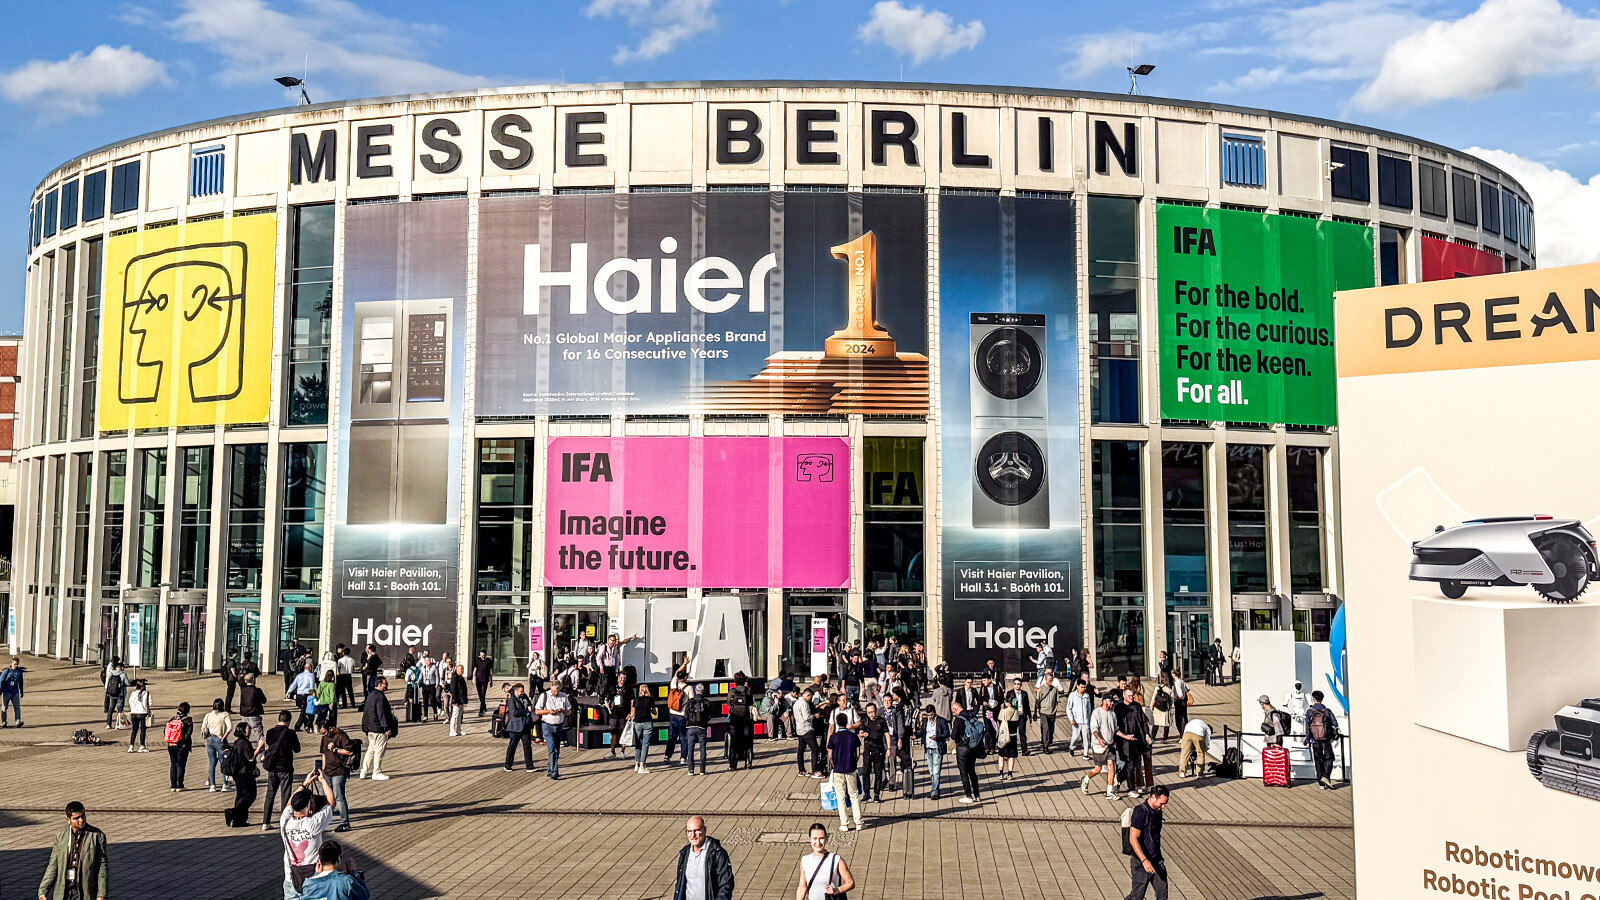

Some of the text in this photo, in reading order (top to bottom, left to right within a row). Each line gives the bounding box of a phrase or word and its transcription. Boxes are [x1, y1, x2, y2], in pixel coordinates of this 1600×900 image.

[290, 109, 1137, 185] MESSE BERLIN
[1173, 226, 1217, 257] IFA
[523, 236, 778, 315] Haier
[854, 250, 865, 330] GLOBAL NO.1
[1175, 280, 1305, 313] For the bold.
[523, 330, 767, 347] No.1 Global Major Appliances Brand
[1175, 312, 1334, 347] For the curious.
[563, 347, 729, 361] for 16 Consecutive Years
[845, 344, 876, 354] 2024
[1176, 345, 1312, 377] For the keen.
[1177, 377, 1249, 405] For all.
[561, 453, 613, 482] IFA
[864, 472, 921, 505] IFA
[559, 510, 666, 541] Imagine
[558, 544, 696, 570] the future.
[347, 581, 366, 590] Hall
[368, 581, 381, 590] 3.1
[390, 581, 419, 591] Booth
[422, 582, 442, 591] 101.
[348, 567, 441, 579] Visit Haier Pavilion,
[960, 569, 1064, 580] Visit Haier Pavilion,
[960, 583, 981, 592] Hall
[984, 583, 999, 592] 3.1
[1010, 582, 1040, 592] Booth
[1044, 583, 1065, 592] 101.
[351, 616, 433, 646] Haier
[618, 597, 753, 684] IFA
[968, 619, 1058, 649] Haier
[1423, 869, 1510, 900] Robotic
